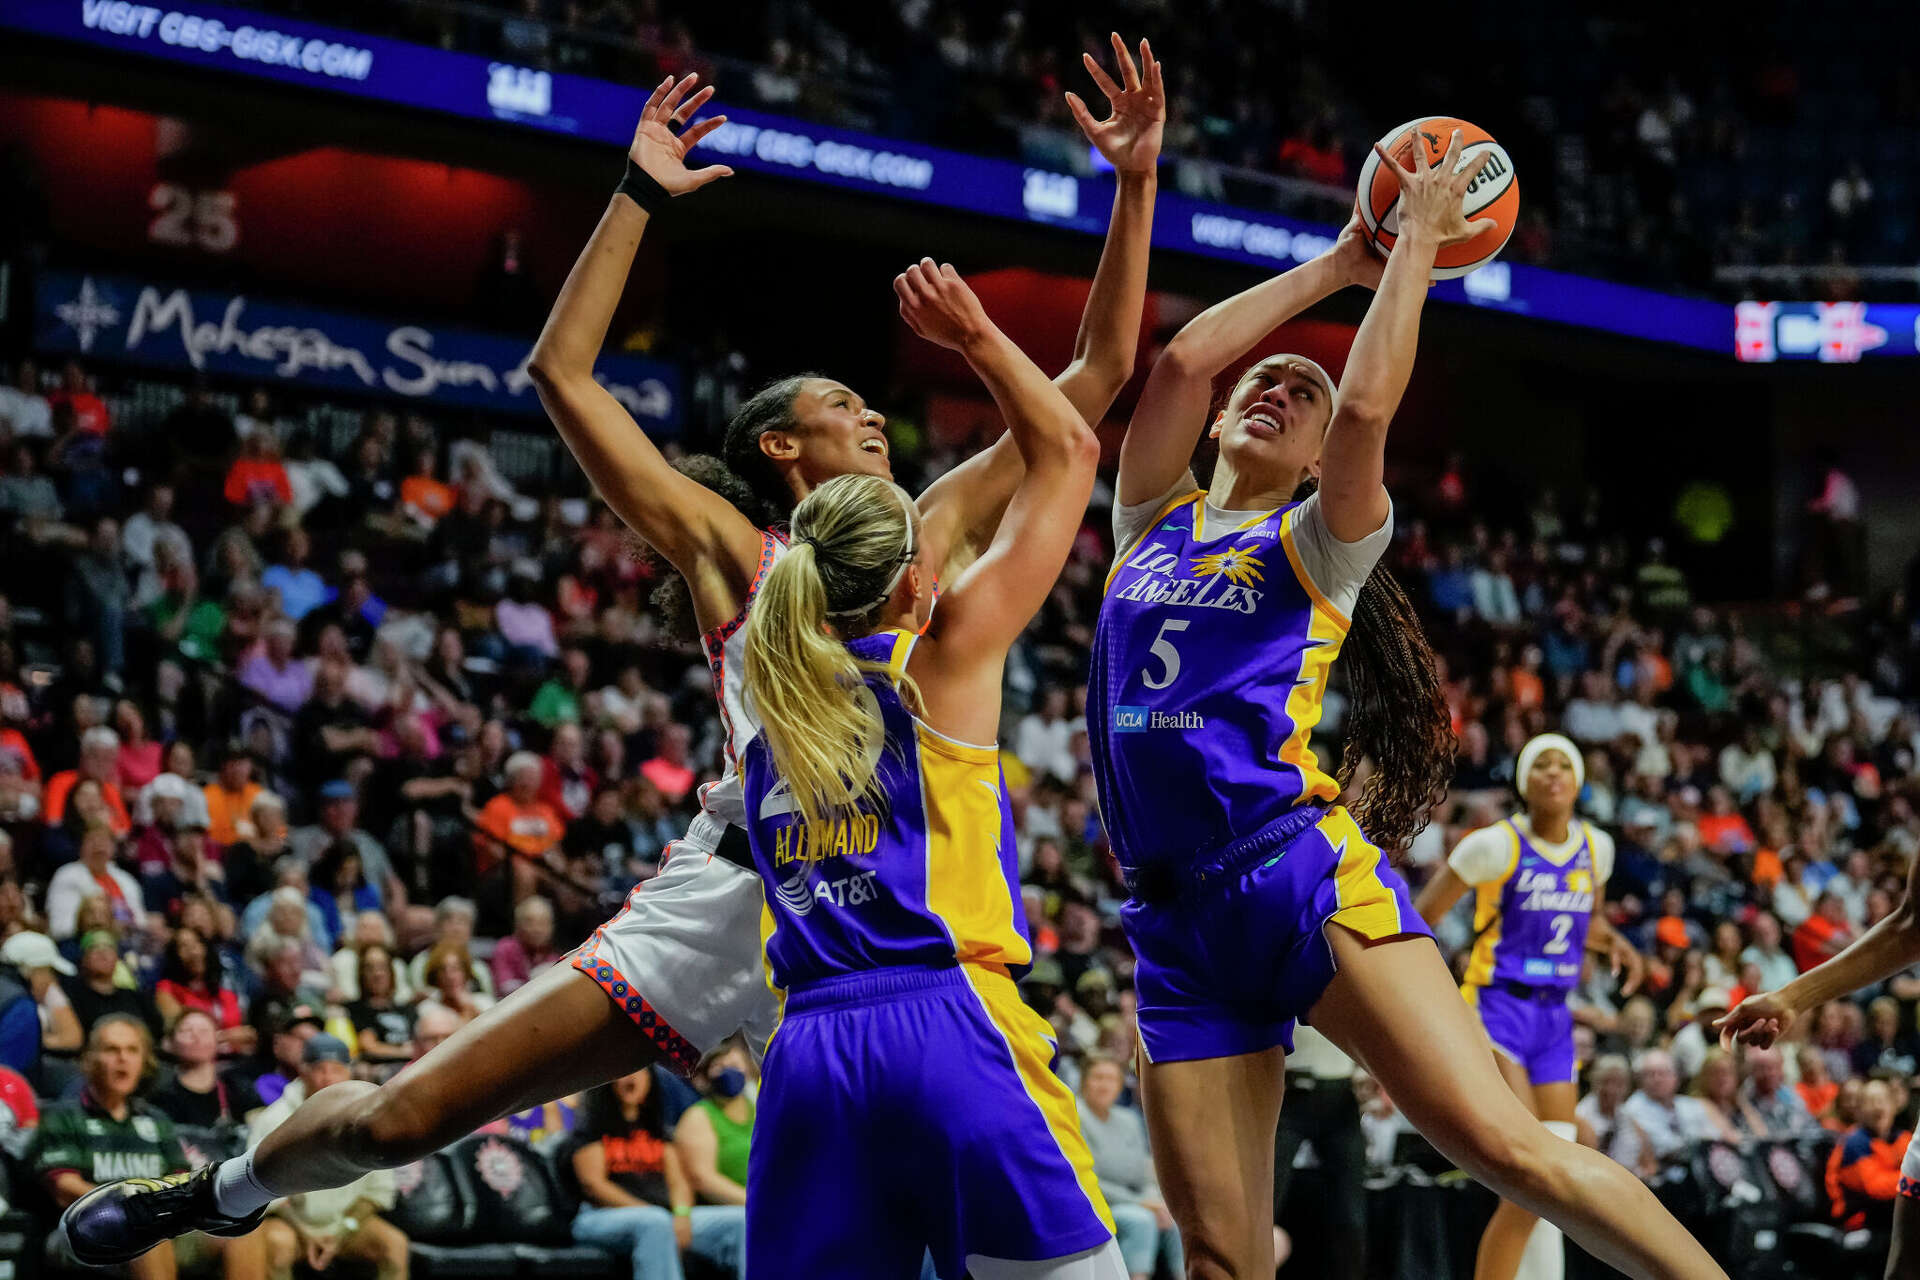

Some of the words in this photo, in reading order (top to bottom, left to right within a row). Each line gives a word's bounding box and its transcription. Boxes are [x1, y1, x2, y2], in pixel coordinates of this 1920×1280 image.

[82, 0, 162, 38] VISIT
[149, 183, 239, 251] 25
[382, 326, 498, 396] Sun
[1115, 571, 1265, 614] ANGELES
[1141, 618, 1191, 690] 5
[1116, 712, 1144, 728] UCLA
[1150, 711, 1204, 729] Health
[813, 869, 878, 907] AT&T
[1542, 913, 1574, 955] 2
